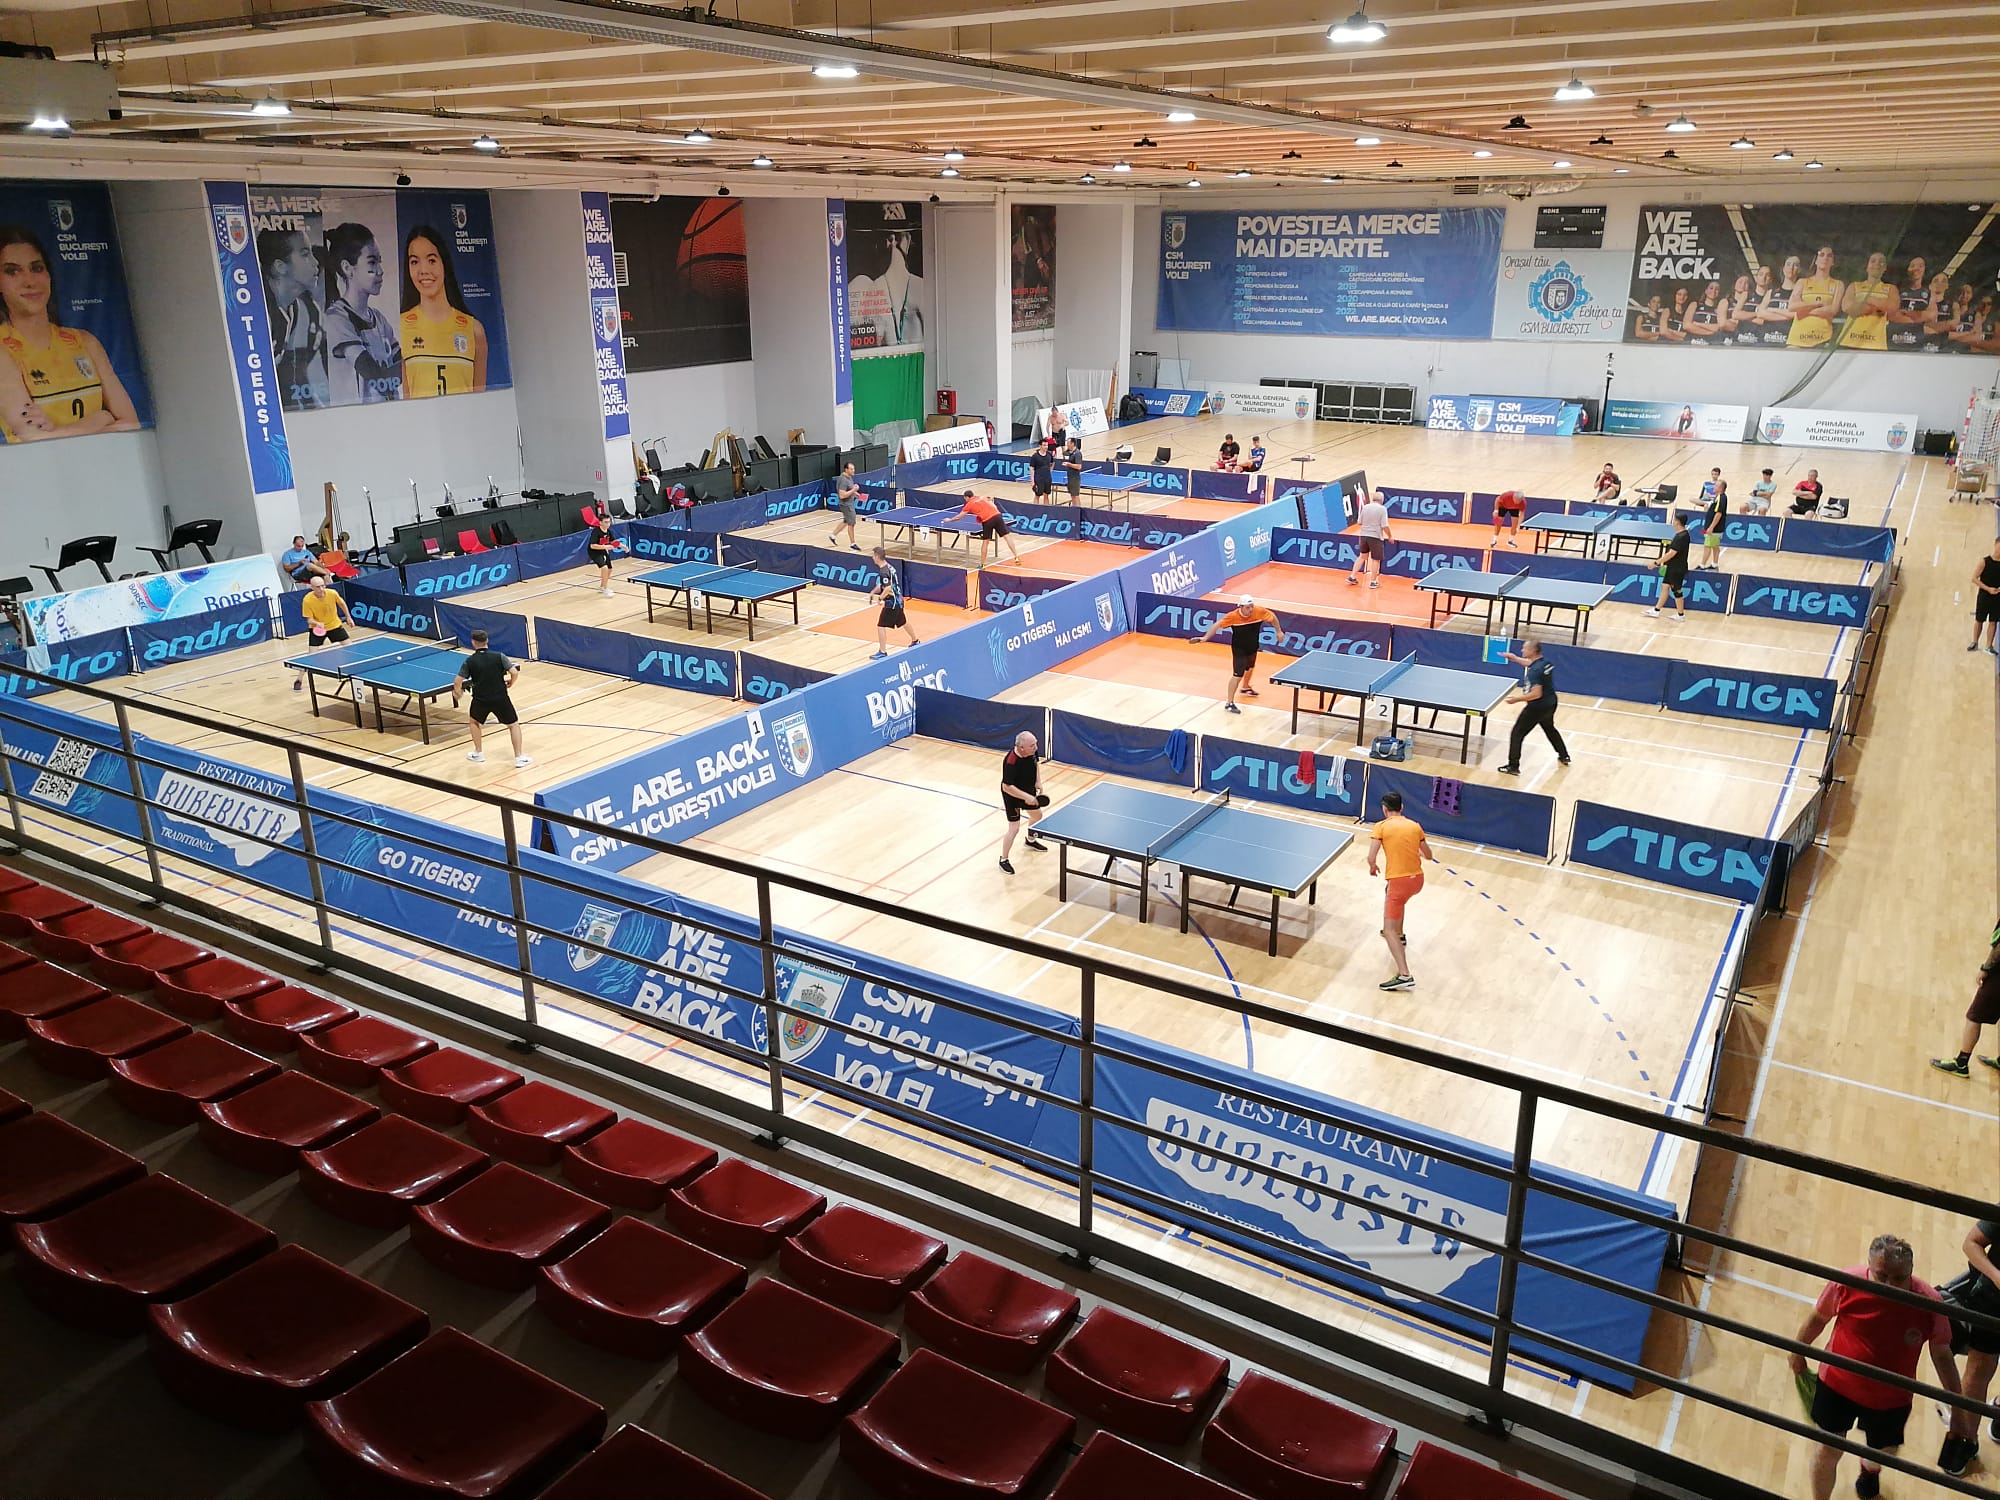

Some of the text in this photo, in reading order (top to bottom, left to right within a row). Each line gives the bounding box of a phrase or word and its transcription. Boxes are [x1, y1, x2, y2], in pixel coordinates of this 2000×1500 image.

[584, 209, 605, 220] WE.
[1237, 213, 1442, 236] POVESTEA MERGE
[1645, 211, 1698, 234] WE.
[586, 220, 609, 232] ARE.
[57, 233, 77, 241] CSM
[1640, 234, 1705, 256] ARE.
[61, 252, 88, 261] VOLEI
[1165, 251, 1183, 260] CSM
[1236, 238, 1390, 258] MAI DEPARTE.
[587, 266, 609, 278] ARE.
[1165, 261, 1211, 273] BUCUREȘTI
[1504, 255, 1533, 270] Orașul
[1638, 257, 1721, 280] BACK.
[1165, 271, 1189, 280] VOLEI
[1411, 316, 1440, 325] DIVIZIA
[1579, 305, 1609, 320] Echipa
[1519, 321, 1592, 337] CSM BUCUREȘTI
[233, 268, 270, 442] GO TIGERS!
[597, 358, 620, 370] ARE.
[601, 383, 622, 395] WE.
[604, 393, 626, 405] ARE.
[1230, 393, 1261, 401] CONSILIUL
[1430, 408, 1459, 420] ARE.
[1432, 399, 1457, 409] WE.
[1498, 402, 1521, 412] CSM
[1428, 418, 1465, 431] BACK.
[1495, 423, 1526, 434] VOLEI
[1496, 412, 1555, 427] BUCUREȘTI
[1815, 420, 1858, 429] PRIMĂRIA
[1805, 428, 1865, 437] MUNICIPIULUI
[1808, 435, 1859, 444] BUCUREȘTI
[932, 437, 985, 456] BUCHAREST
[766, 494, 818, 517] andro
[827, 492, 890, 512] adro
[1383, 496, 1457, 517] STIGA
[1002, 512, 1072, 535] andro
[635, 537, 709, 561] andro
[1249, 531, 1270, 549] BORSEC
[1278, 538, 1358, 562] STIGA
[1599, 539, 1607, 549] 4
[1387, 549, 1474, 572] STIGA
[415, 563, 508, 597] andro
[812, 563, 881, 589] andr
[1151, 560, 1199, 595] BORSEC
[692, 595, 700, 608] 6
[1743, 587, 1857, 619] STIGA
[350, 600, 430, 633] andro
[1026, 610, 1032, 622] 2
[144, 617, 263, 662] andro
[1006, 619, 1057, 652] GO TIGERS!
[1054, 620, 1092, 648] HAI CSM!
[1258, 622, 1376, 659] andro
[638, 650, 729, 688] STIGA
[1679, 677, 1820, 718] STIGA
[1379, 703, 1389, 717] 2
[752, 720, 761, 735] 1
[196, 760, 287, 798] RESTAURANT
[564, 739, 770, 840] WE. ARE. BACK.
[160, 778, 287, 842] BUREBISTA
[618, 784, 728, 837] BUCUREȘTI
[727, 763, 777, 796] VOLEI
[160, 825, 215, 854] TRADITIONAL
[1587, 825, 1767, 889] STIGA
[377, 846, 482, 895] GO TIGERS!
[1163, 872, 1174, 889] 1
[666, 914, 732, 965] WE.
[648, 948, 730, 1004] ARE.
[861, 977, 937, 1025] CSM
[632, 981, 737, 1045] BACK.
[844, 1012, 1046, 1108] BUCUREȘTI
[833, 1053, 936, 1114] VOLEI
[1213, 1091, 1440, 1180] RESTAURANT
[1157, 1113, 1468, 1261] BUREBISTA
